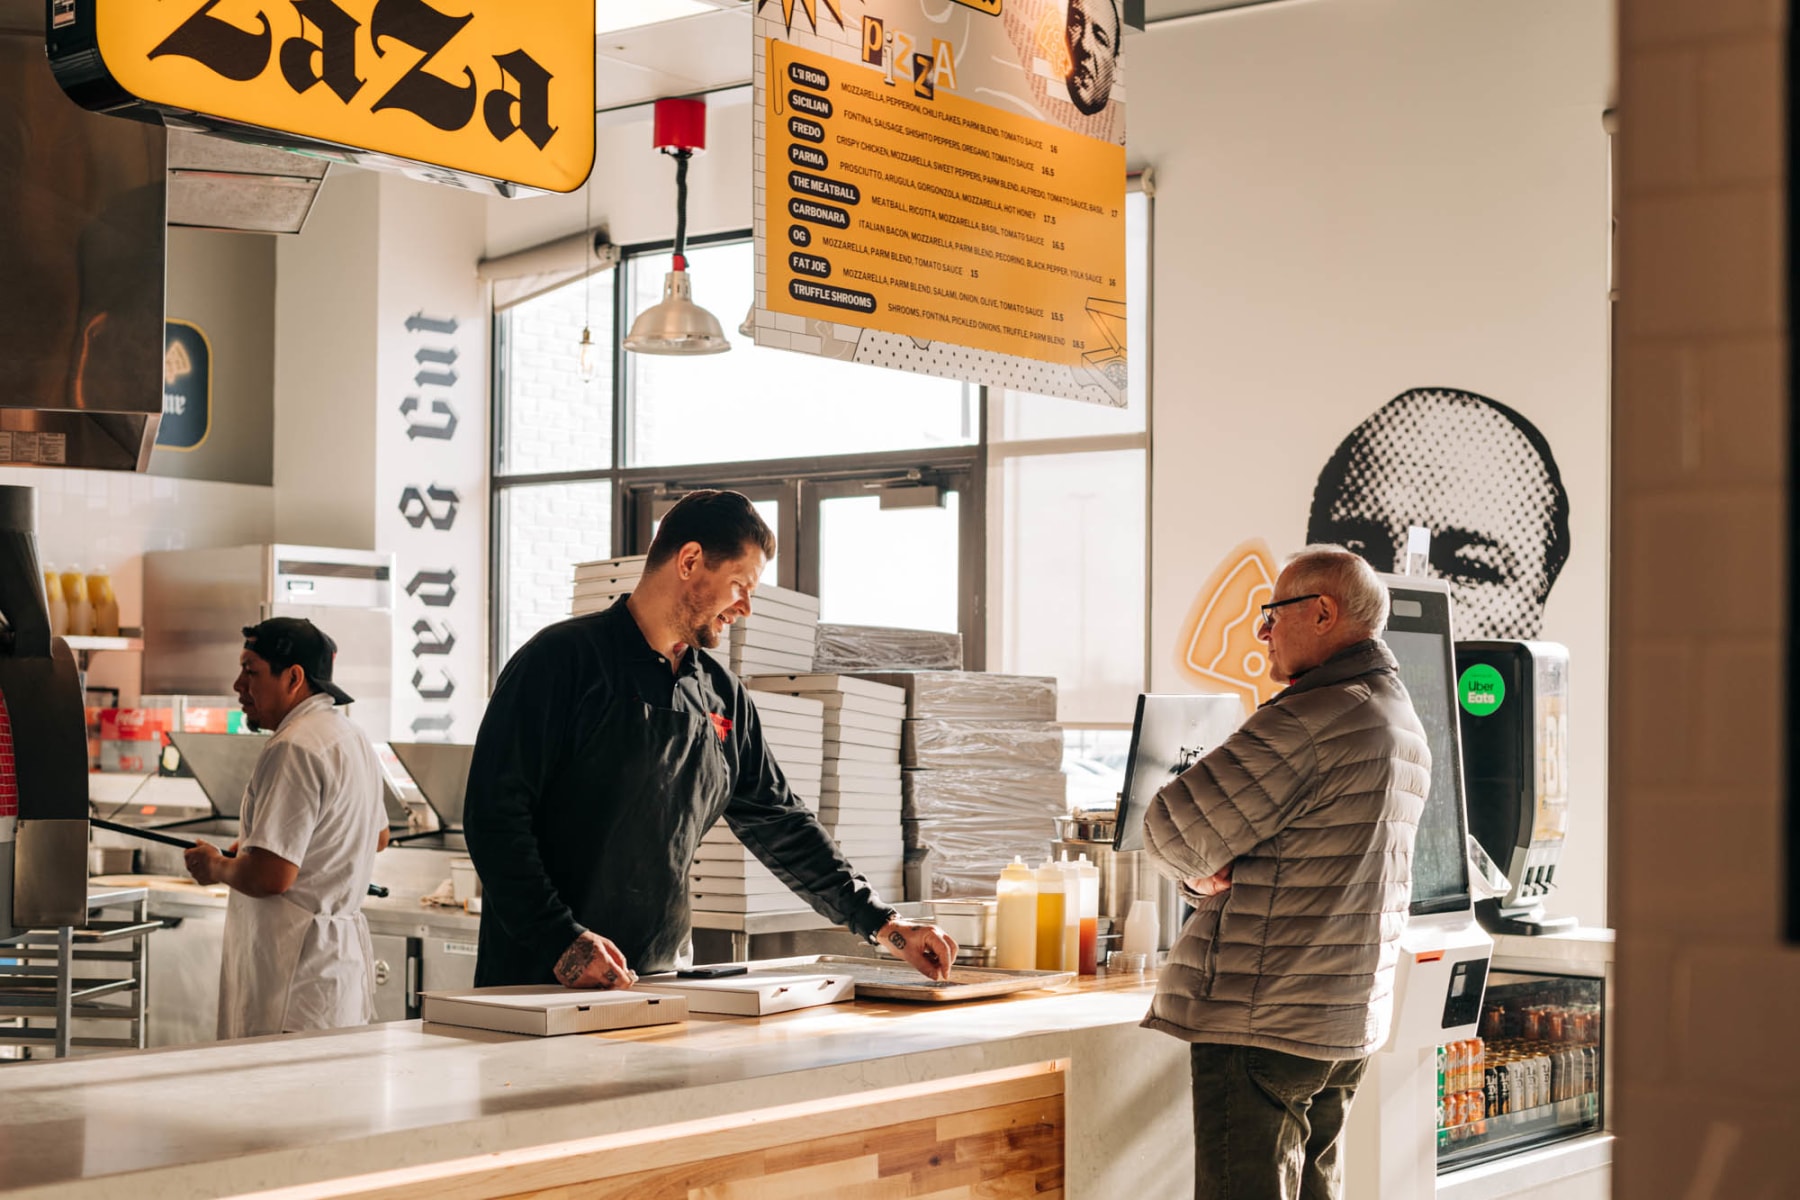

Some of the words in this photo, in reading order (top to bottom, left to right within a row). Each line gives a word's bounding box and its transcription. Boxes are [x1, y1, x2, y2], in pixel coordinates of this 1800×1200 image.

[792, 94, 828, 113] SICILIAN
[905, 127, 932, 142] SHISHITO
[991, 151, 1015, 166] TOMATO
[1016, 158, 1034, 171] SAUCE
[1041, 165, 1054, 177] 16.5
[805, 71, 826, 86] RONI
[921, 106, 937, 118] CHILI
[962, 118, 979, 131] PARM
[1000, 129, 1024, 144] TOMATO
[1024, 136, 1042, 149] SAUCE
[1050, 144, 1057, 154] 16
[792, 121, 821, 138] FREDO
[836, 135, 859, 149] CRISPY
[933, 161, 954, 174] SWEET
[982, 174, 999, 186] PARM
[1046, 191, 1068, 205] TOMATO
[1111, 208, 1117, 218] 17
[792, 148, 824, 166] PARMA
[1003, 203, 1015, 214] HOT
[1016, 207, 1035, 219] HONEY
[1043, 214, 1055, 224] 17.5
[793, 175, 809, 188] THE
[811, 179, 856, 200] MEATBALL
[1000, 227, 1024, 241] TOMATO
[1025, 233, 1044, 245] SAUCE
[1052, 239, 1064, 250] 16.5
[793, 202, 846, 223] CARBONARA
[858, 219, 885, 233] ITALIAN
[954, 241, 972, 253] PARM
[1026, 258, 1044, 270] BLACK
[1085, 272, 1102, 284] SAUCE
[1109, 278, 1115, 287] 16
[793, 230, 806, 241] OG
[870, 247, 889, 259] PARM
[914, 256, 941, 270] TOMATO
[942, 263, 962, 275] SAUCE
[970, 269, 978, 278] 15
[793, 257, 810, 269] FAT
[811, 260, 826, 272] JOE
[890, 277, 908, 289] PARM
[999, 300, 1024, 314] TOMATO
[1025, 306, 1043, 318] SAUCE
[1051, 311, 1064, 322] 15.5
[793, 284, 830, 300] TRUFFLE
[831, 291, 872, 308] SHROOMS
[951, 315, 976, 328] PICKLED
[1029, 330, 1046, 342] PARM
[1046, 334, 1064, 345] BLEND
[398, 310, 459, 441] Cut
[398, 484, 460, 531] &
[1468, 680, 1494, 692] Uber
[1468, 692, 1495, 704] Eats
